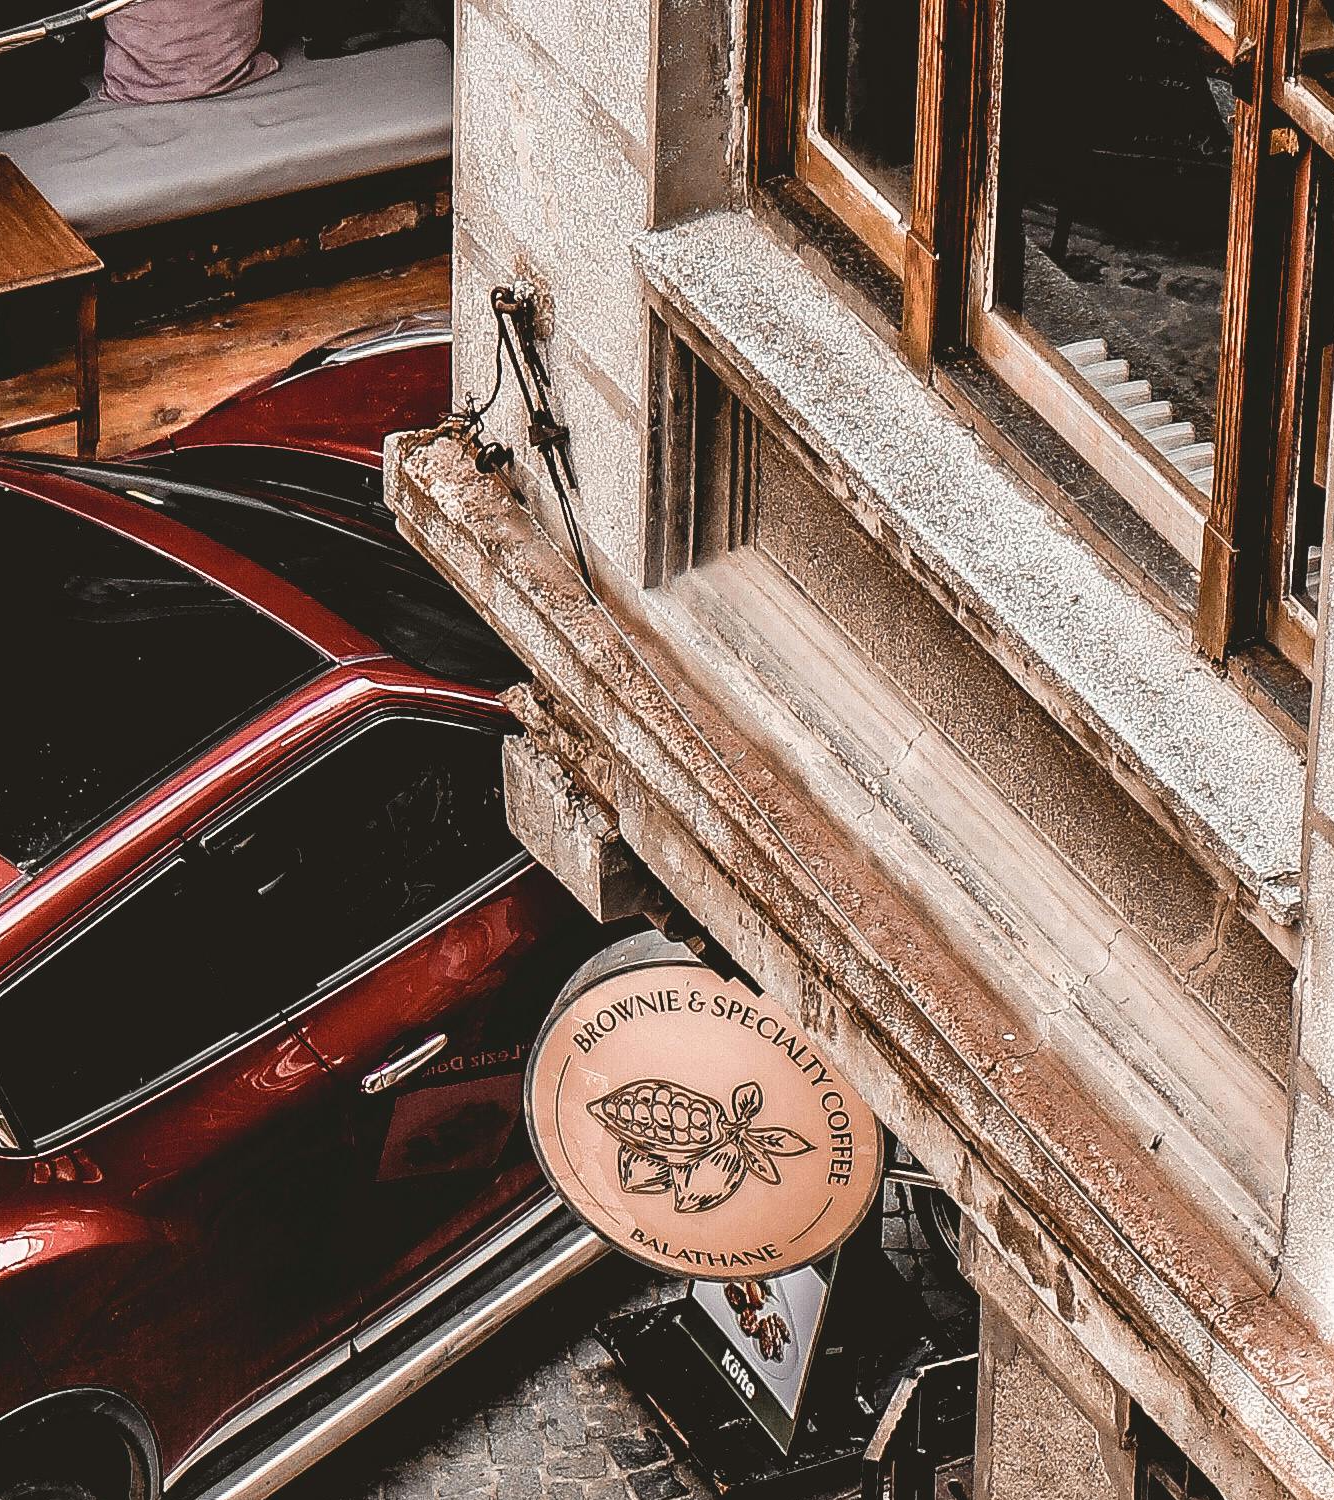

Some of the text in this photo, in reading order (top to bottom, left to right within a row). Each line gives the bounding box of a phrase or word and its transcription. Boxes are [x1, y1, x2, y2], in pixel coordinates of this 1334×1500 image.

[572, 989, 854, 1187] BROWNIE & SPECIALTY COFFEE
[630, 1227, 784, 1268] BALATHANE
[721, 1348, 755, 1400] Köfte
